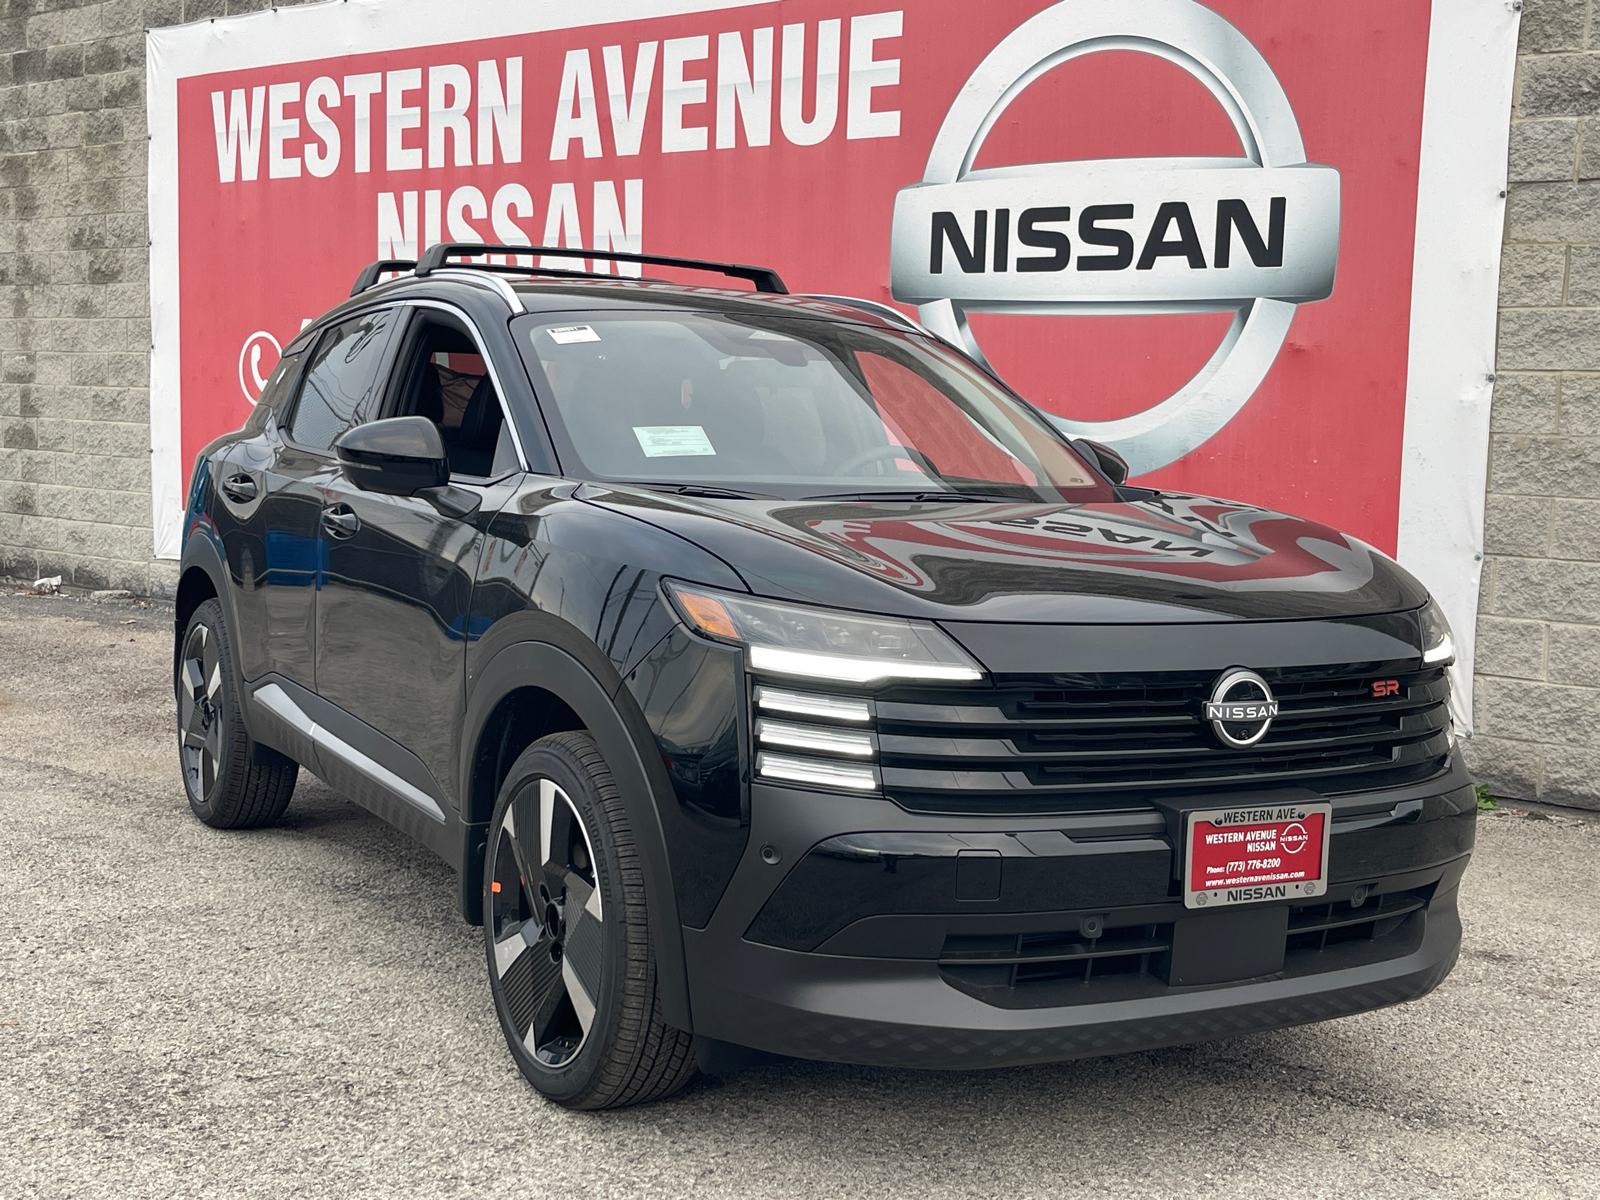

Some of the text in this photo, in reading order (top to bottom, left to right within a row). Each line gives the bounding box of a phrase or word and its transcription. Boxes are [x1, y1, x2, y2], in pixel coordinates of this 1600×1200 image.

[211, 10, 904, 183] WESTERN AVENUE
[377, 179, 643, 283] NISSAN
[930, 197, 1287, 274] NISSAN
[1371, 679, 1400, 697] SR
[1209, 703, 1279, 719] NISSAN
[1223, 808, 1298, 824] WESTERN AVE.
[1205, 829, 1277, 845] WESTERN AVENUE
[1279, 834, 1308, 843] NISSAN
[1246, 841, 1276, 853] NISSAN
[1206, 857, 1281, 875] Phone: (773) 776-8200
[1205, 870, 1305, 887] www.westernavenissan.com
[1227, 885, 1286, 902] NISSAN
